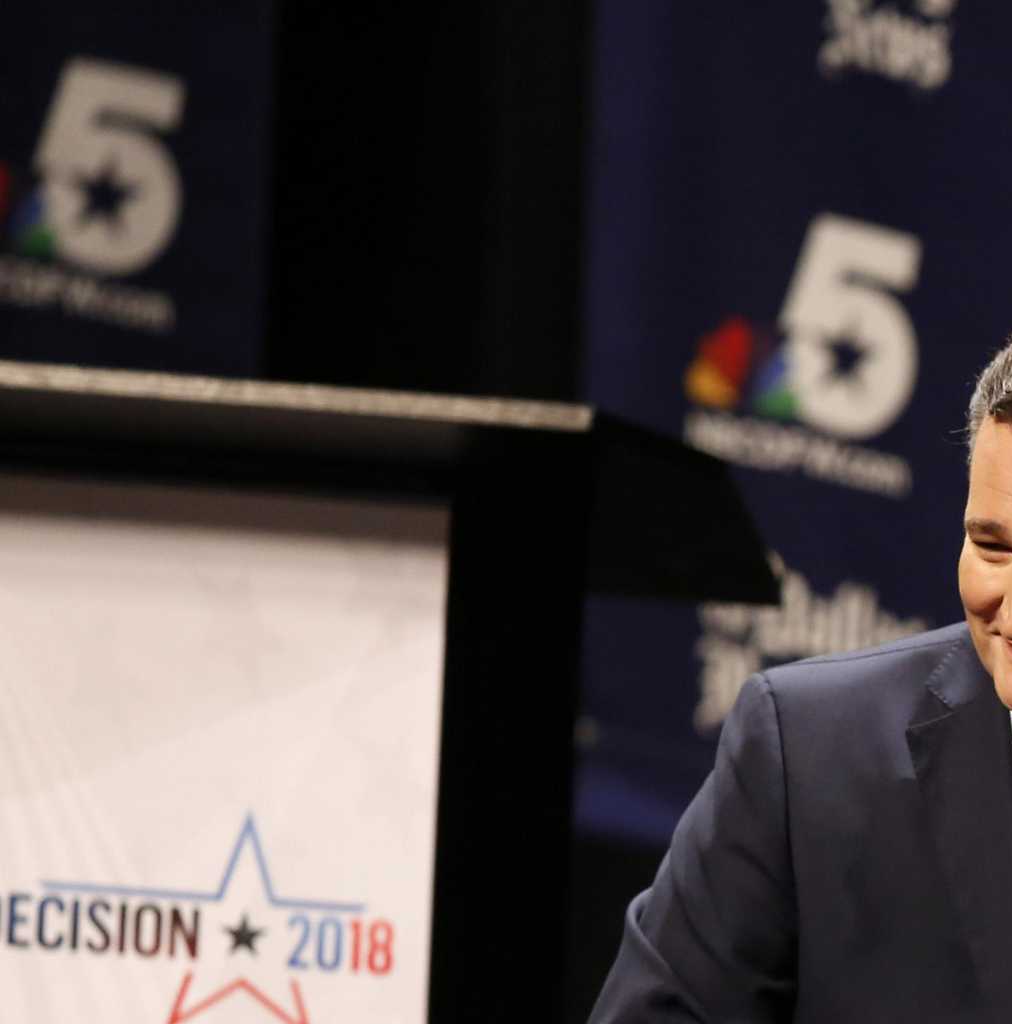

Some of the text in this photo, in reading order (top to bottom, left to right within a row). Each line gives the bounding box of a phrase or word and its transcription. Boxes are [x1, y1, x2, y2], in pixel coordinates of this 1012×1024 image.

[34, 57, 187, 277] 5
[780, 213, 921, 440] 5
[0, 893, 395, 977] ECISION 2018
